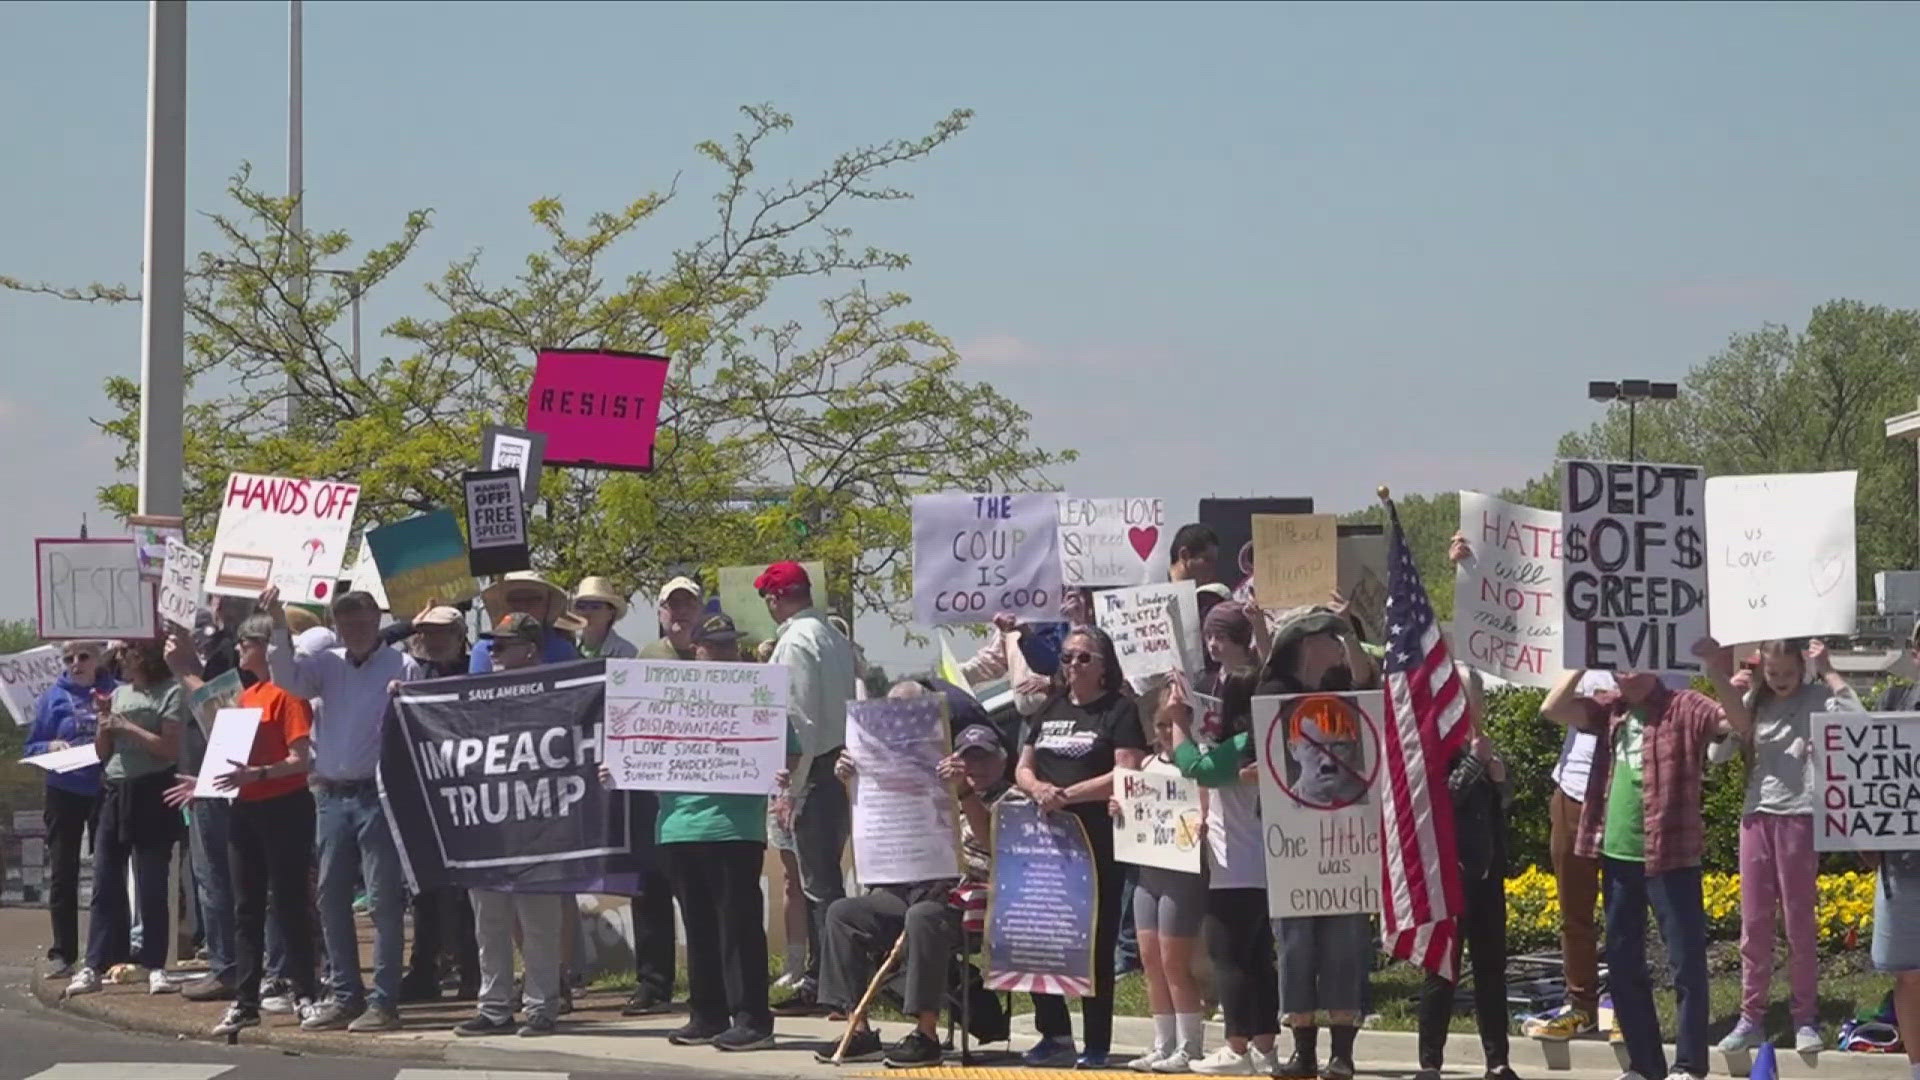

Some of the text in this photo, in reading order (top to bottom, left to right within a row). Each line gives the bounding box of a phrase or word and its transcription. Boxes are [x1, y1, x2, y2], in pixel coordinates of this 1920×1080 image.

[540, 389, 645, 420] RESIST
[228, 475, 358, 520] HANDS OFF
[475, 491, 511, 506] OFF!
[1567, 461, 1698, 516] DEPT.
[474, 506, 516, 525] FREE
[973, 495, 1011, 520] THE
[1056, 499, 1097, 527] LEAD
[1122, 499, 1165, 527] LOVE
[474, 523, 517, 538] SPEECH
[1483, 510, 1563, 560] HATE
[168, 541, 199, 570] STOP
[953, 530, 1027, 562] COUP
[170, 569, 193, 591] THE
[977, 565, 1007, 588] IS
[1494, 562, 1551, 585] will
[49, 551, 144, 630] RESIST
[160, 586, 196, 617] COUP
[1482, 577, 1552, 616] NOT
[1473, 611, 1523, 635] make
[1469, 630, 1552, 674] GREAT
[644, 666, 760, 684] IMPROVED MEDICARE
[468, 682, 544, 701] SAVE AMERICA
[664, 687, 714, 703] FOR ALL
[647, 702, 673, 715] NOT
[680, 703, 740, 719] MEDICARE
[419, 722, 603, 780] IMPEACH
[633, 741, 667, 755] LOVE
[1824, 724, 1911, 751] EVIL
[439, 775, 586, 826] TRUMP
[1824, 783, 1920, 810] OLIGA
[1267, 816, 1380, 858] One Hitle
[1318, 858, 1351, 875] was
[1290, 875, 1380, 912] enough
